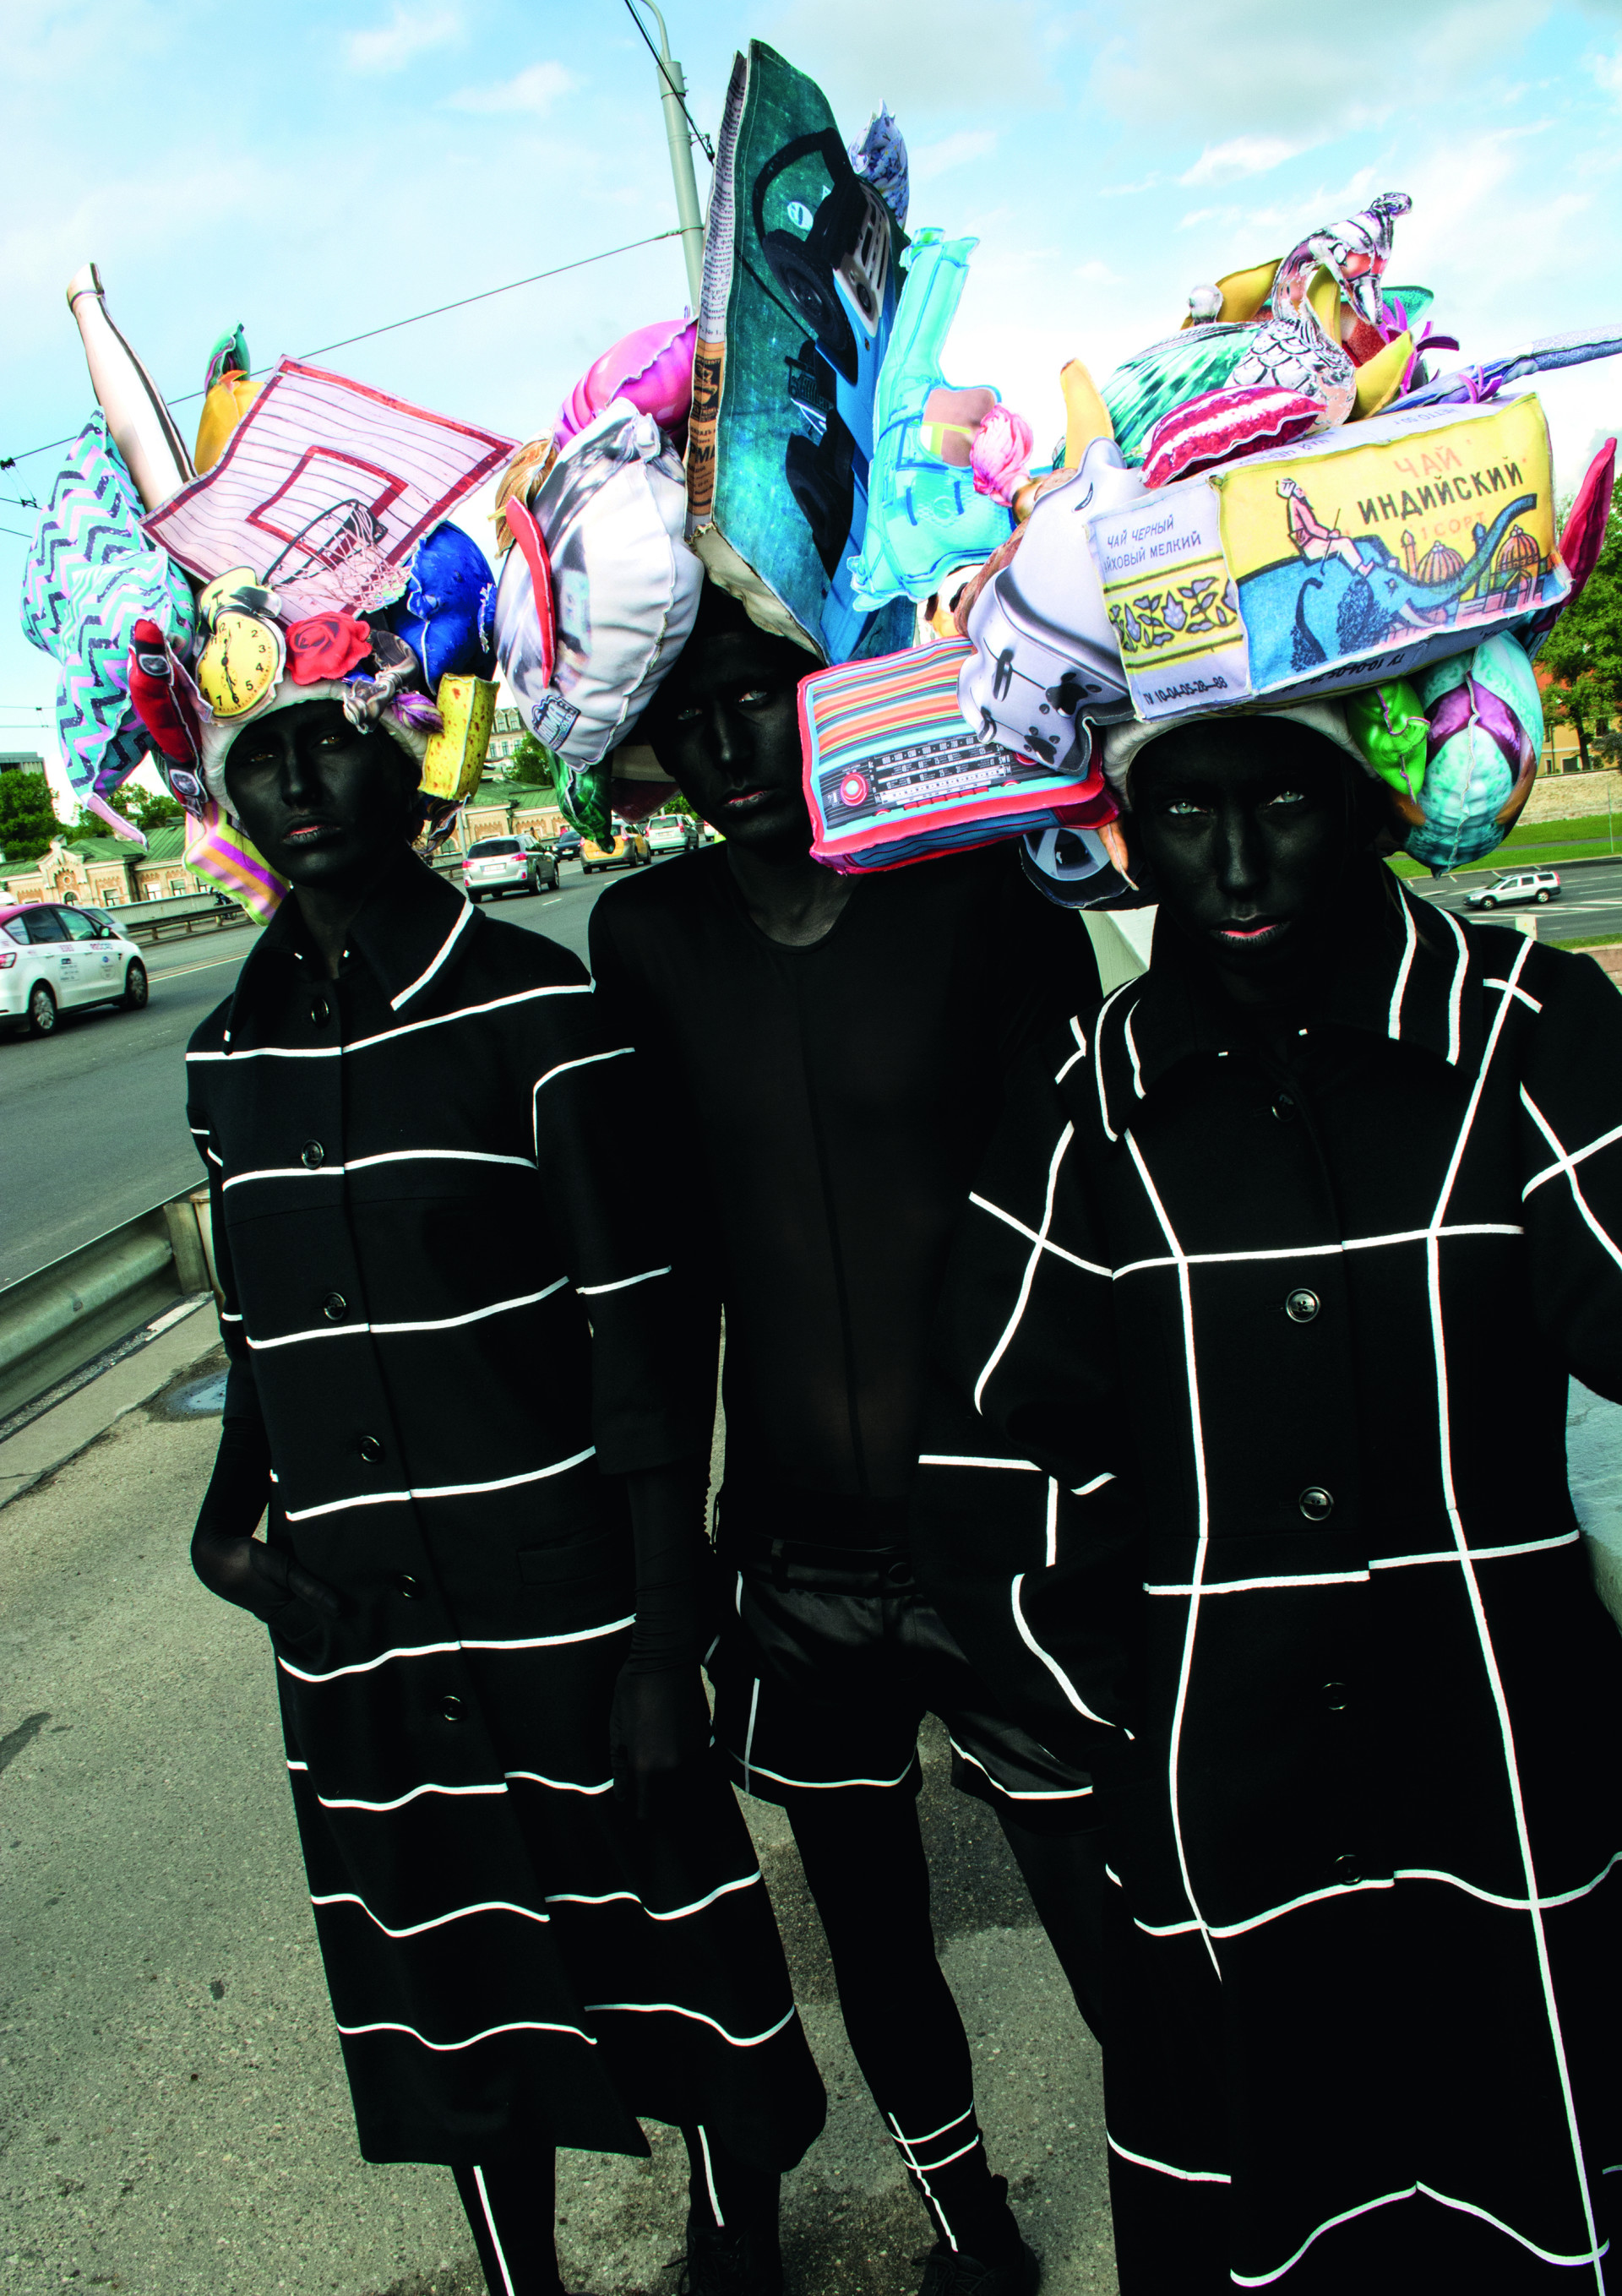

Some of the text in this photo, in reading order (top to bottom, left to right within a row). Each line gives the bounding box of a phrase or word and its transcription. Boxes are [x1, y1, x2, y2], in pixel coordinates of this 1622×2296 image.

[1393, 445, 1462, 478] ЧАЙ
[1357, 455, 1524, 525] ИНДИЙСКИЙ
[1434, 511, 1487, 537] СОРТ
[1108, 514, 1174, 548] ЧАЙ ЧЕРНЫЙ
[1150, 530, 1201, 558] МЕЛКИЙ
[251, 629, 259, 638] 2
[259, 645, 266, 653] 3
[1387, 653, 1405, 666] ТУ
[255, 662, 264, 672] 4
[245, 680, 254, 691] 5
[215, 695, 223, 706] 7
